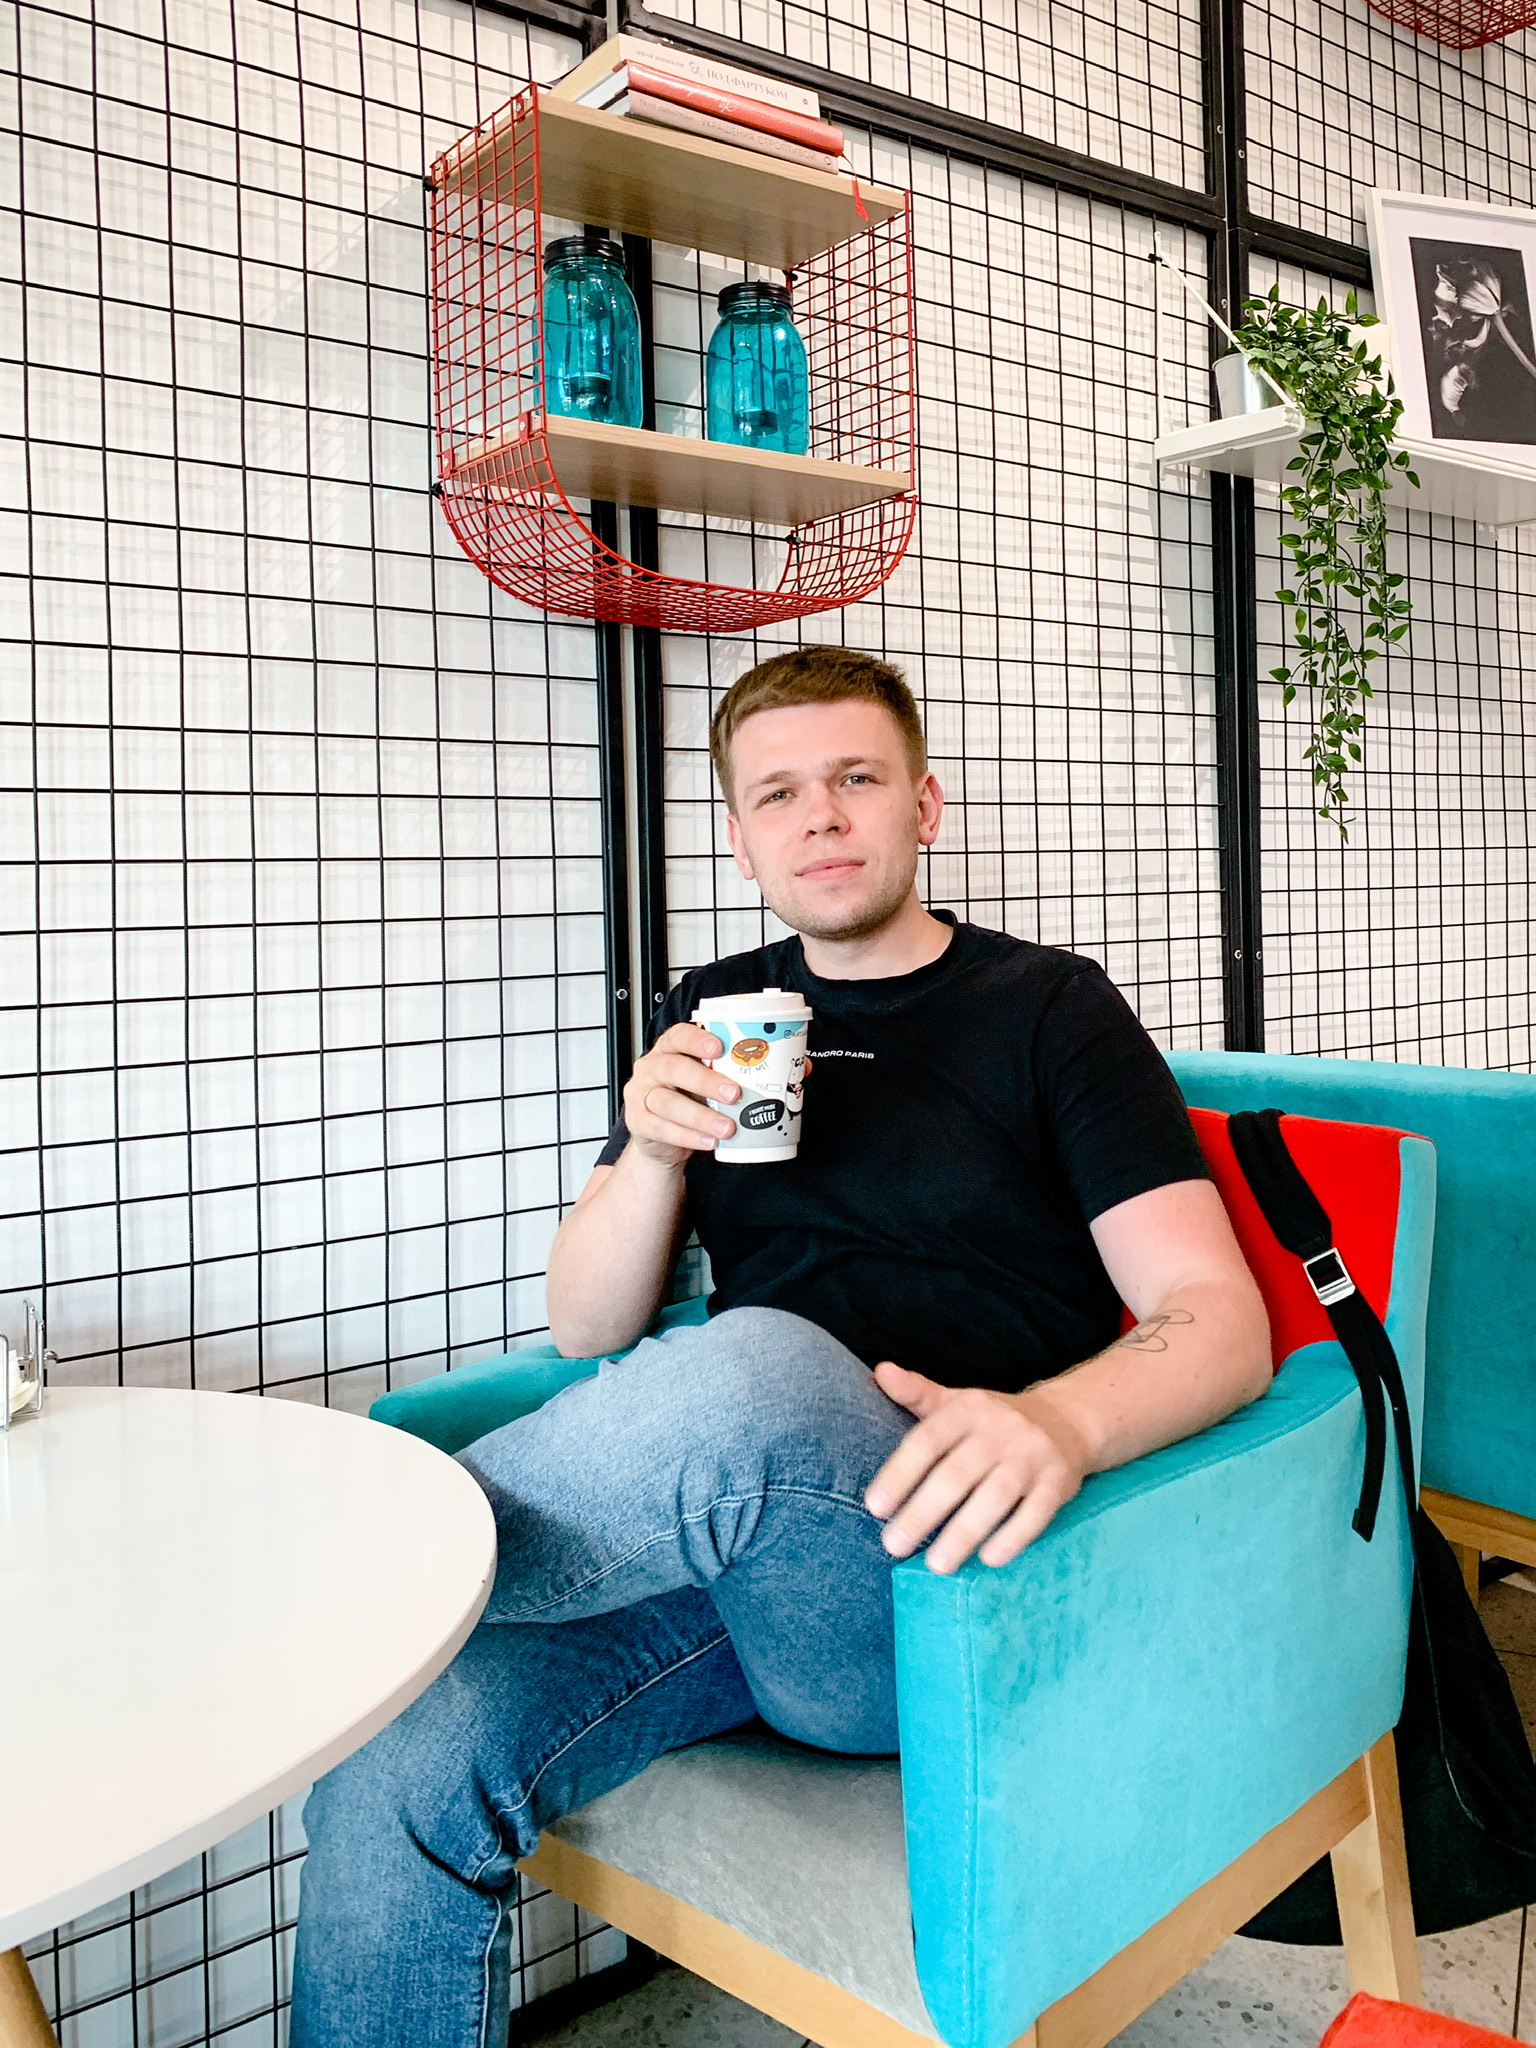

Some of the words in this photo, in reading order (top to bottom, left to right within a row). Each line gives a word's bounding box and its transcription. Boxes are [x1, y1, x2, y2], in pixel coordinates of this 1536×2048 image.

[701, 119, 755, 141] УКРАШЕНИЯ
[844, 1050, 875, 1060] PARIS
[749, 1110, 777, 1126] COFFEE
